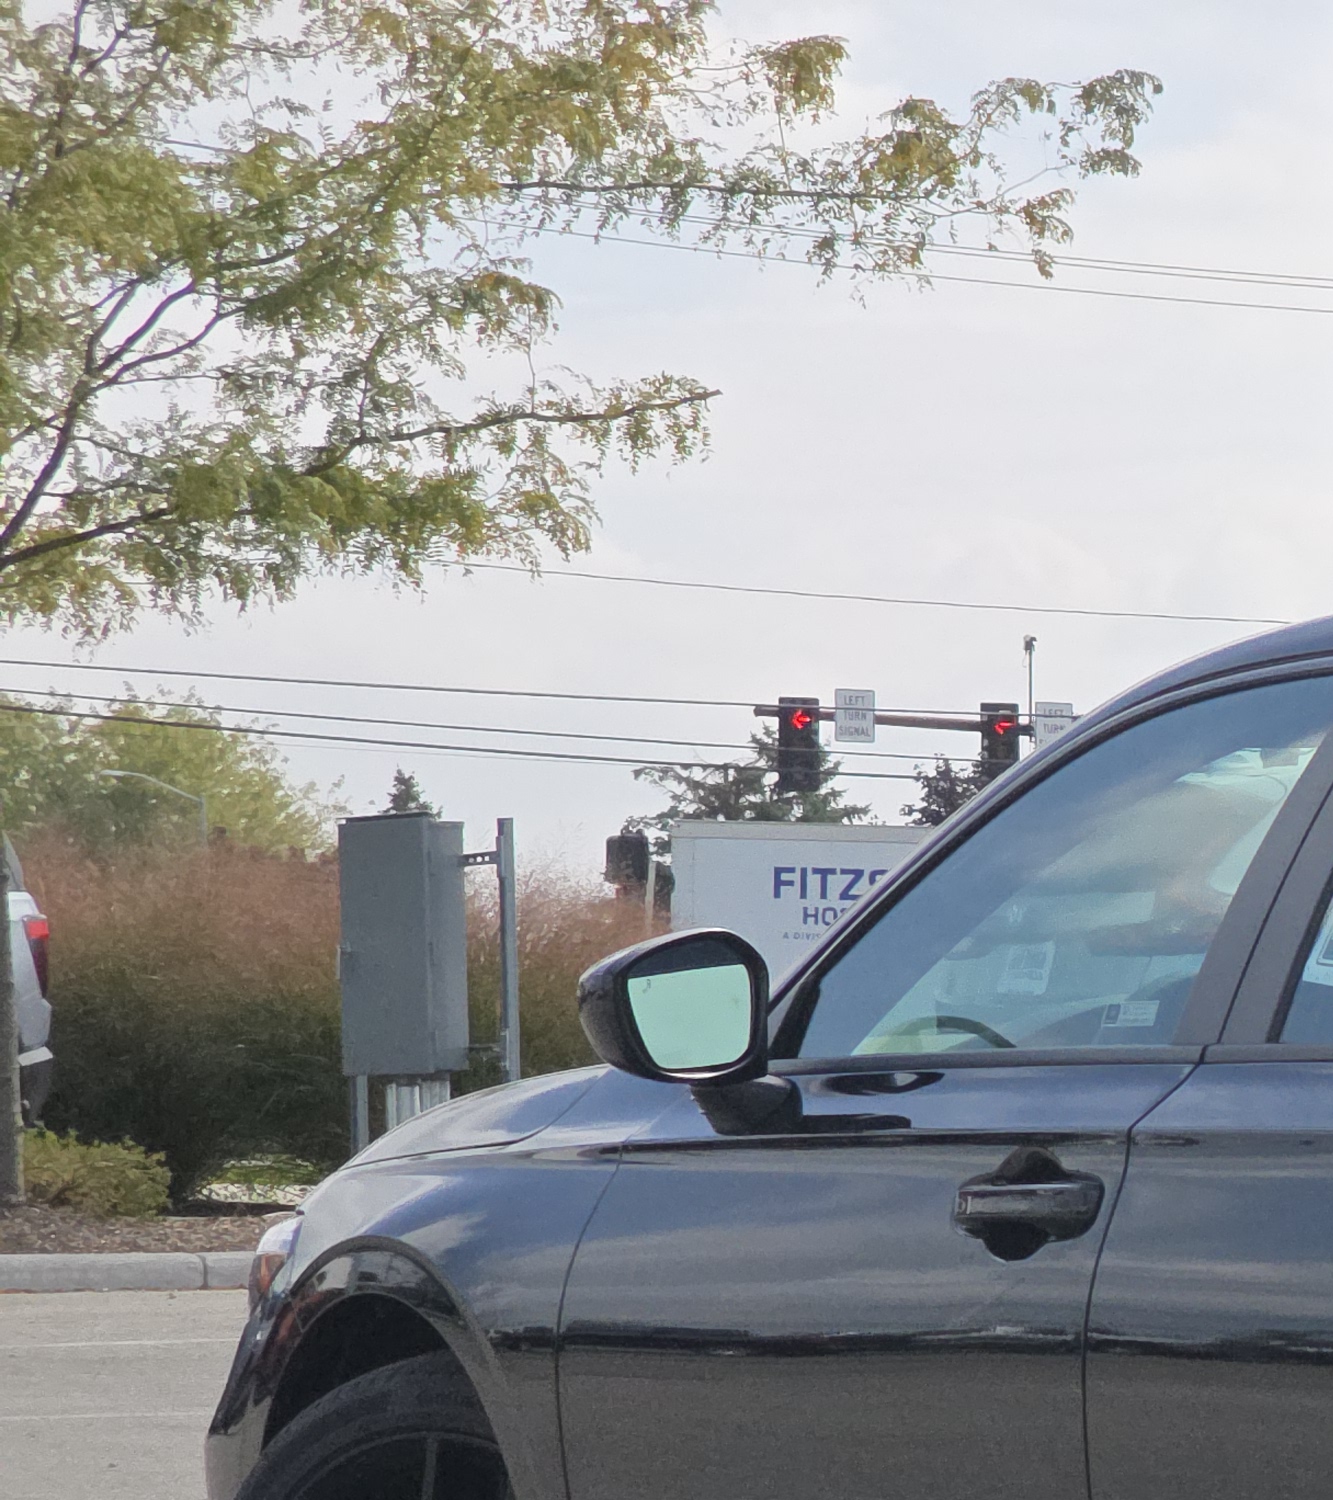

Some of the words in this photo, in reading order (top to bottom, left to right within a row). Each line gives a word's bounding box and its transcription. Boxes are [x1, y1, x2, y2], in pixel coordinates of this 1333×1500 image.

[843, 695, 866, 706] LEFT
[844, 710, 867, 721] TURN
[839, 725, 871, 737] SIGNAL
[802, 906, 848, 926] HO
